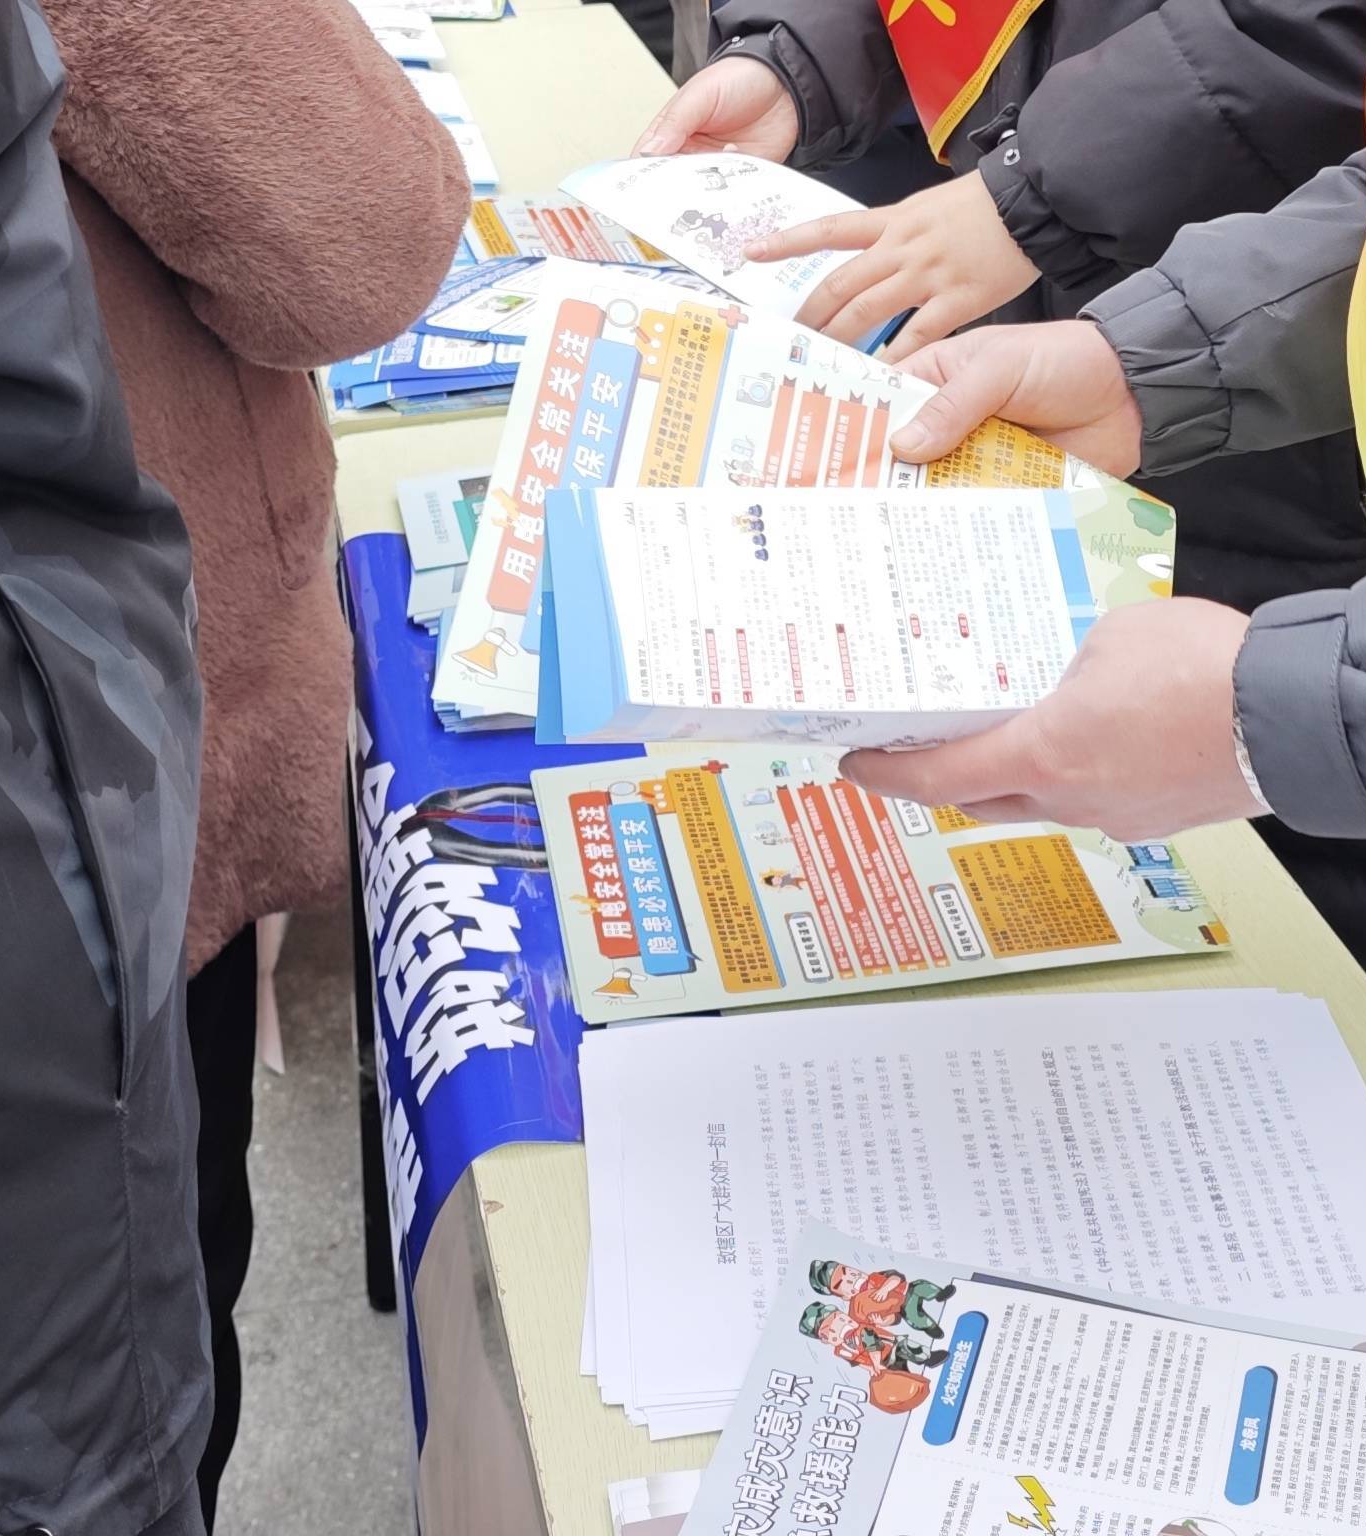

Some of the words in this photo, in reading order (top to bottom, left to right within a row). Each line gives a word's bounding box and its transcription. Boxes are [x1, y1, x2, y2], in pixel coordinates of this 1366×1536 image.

[496, 323, 592, 584] 用电安全常关注
[572, 802, 634, 943] 用电安全常关注
[616, 815, 678, 957] 隐患必究保平安
[707, 1119, 736, 1266] 致辖区广大群众的一封信
[938, 1337, 976, 1407] 火灾如何逃生
[1238, 1414, 1261, 1453] 龙卷风
[789, 1373, 871, 1536] 救援能力
